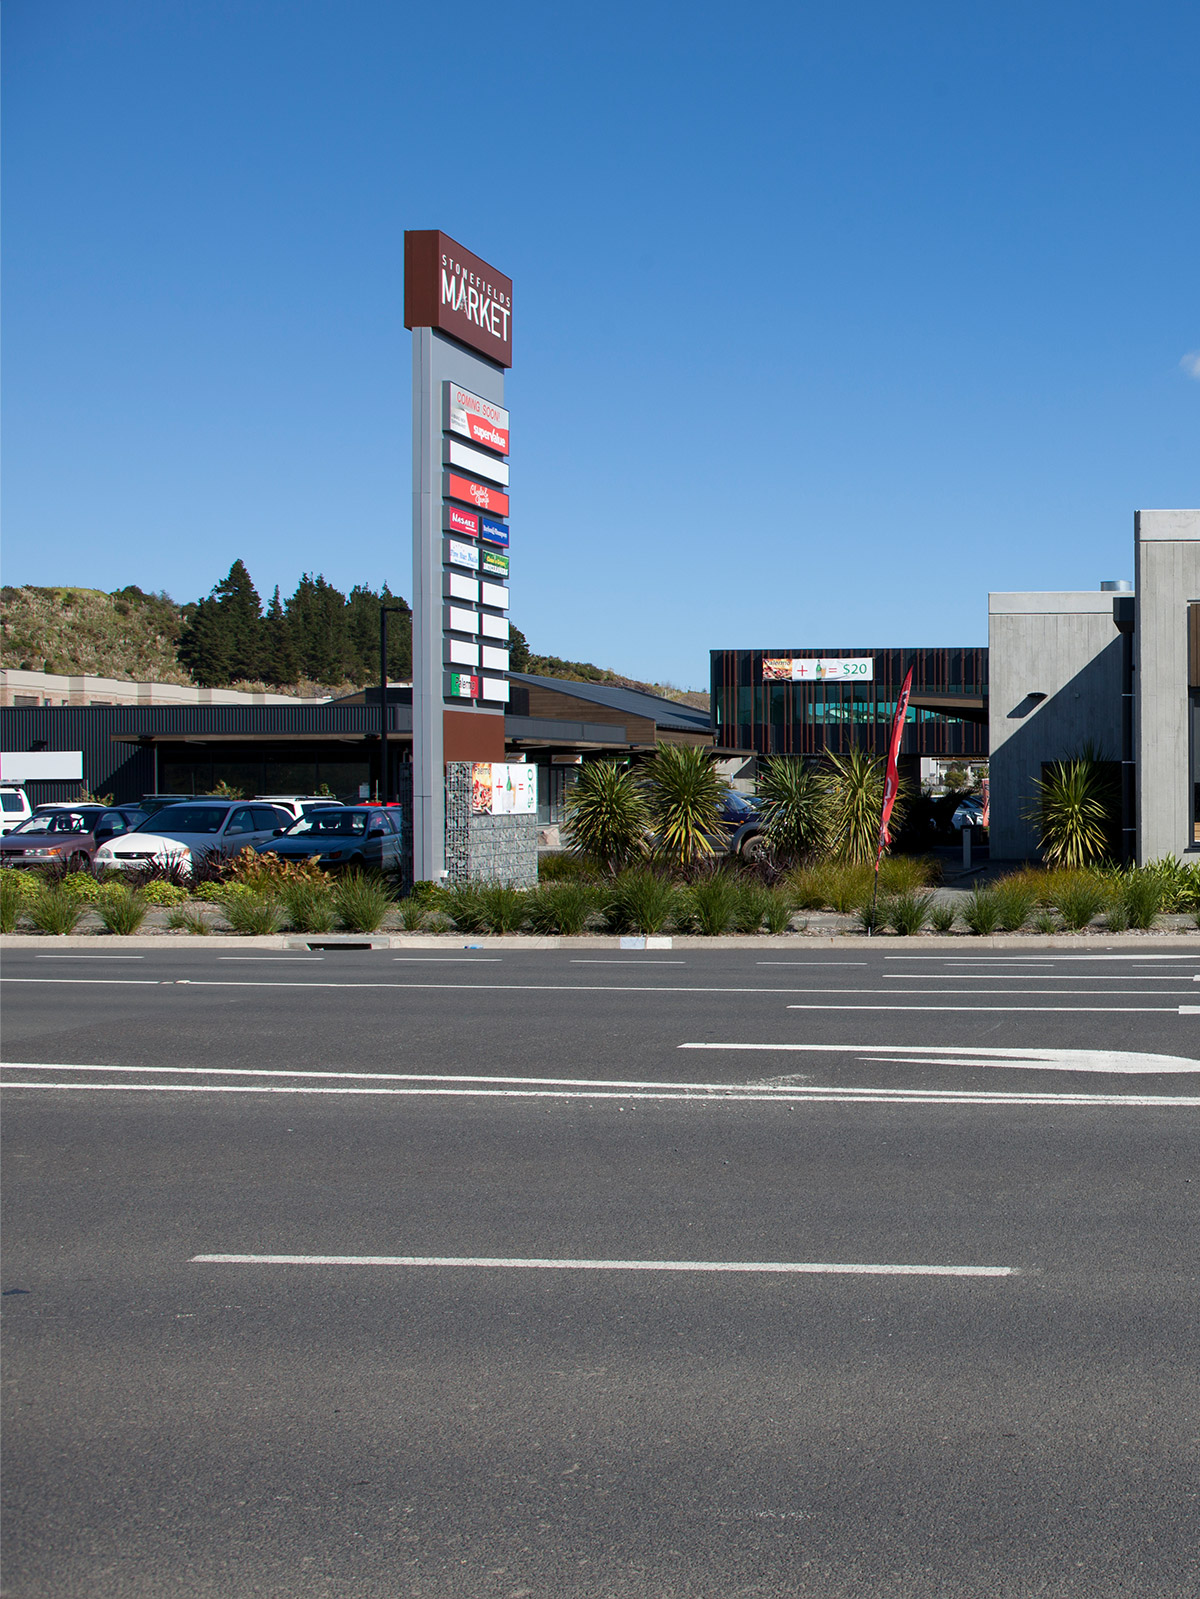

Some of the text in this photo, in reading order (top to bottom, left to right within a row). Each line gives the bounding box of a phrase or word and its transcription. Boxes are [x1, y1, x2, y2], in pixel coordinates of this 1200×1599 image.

[442, 254, 511, 308] STONEFIELDS
[442, 268, 511, 342] MARKET
[456, 391, 481, 412] COMING
[843, 663, 867, 674] $20
